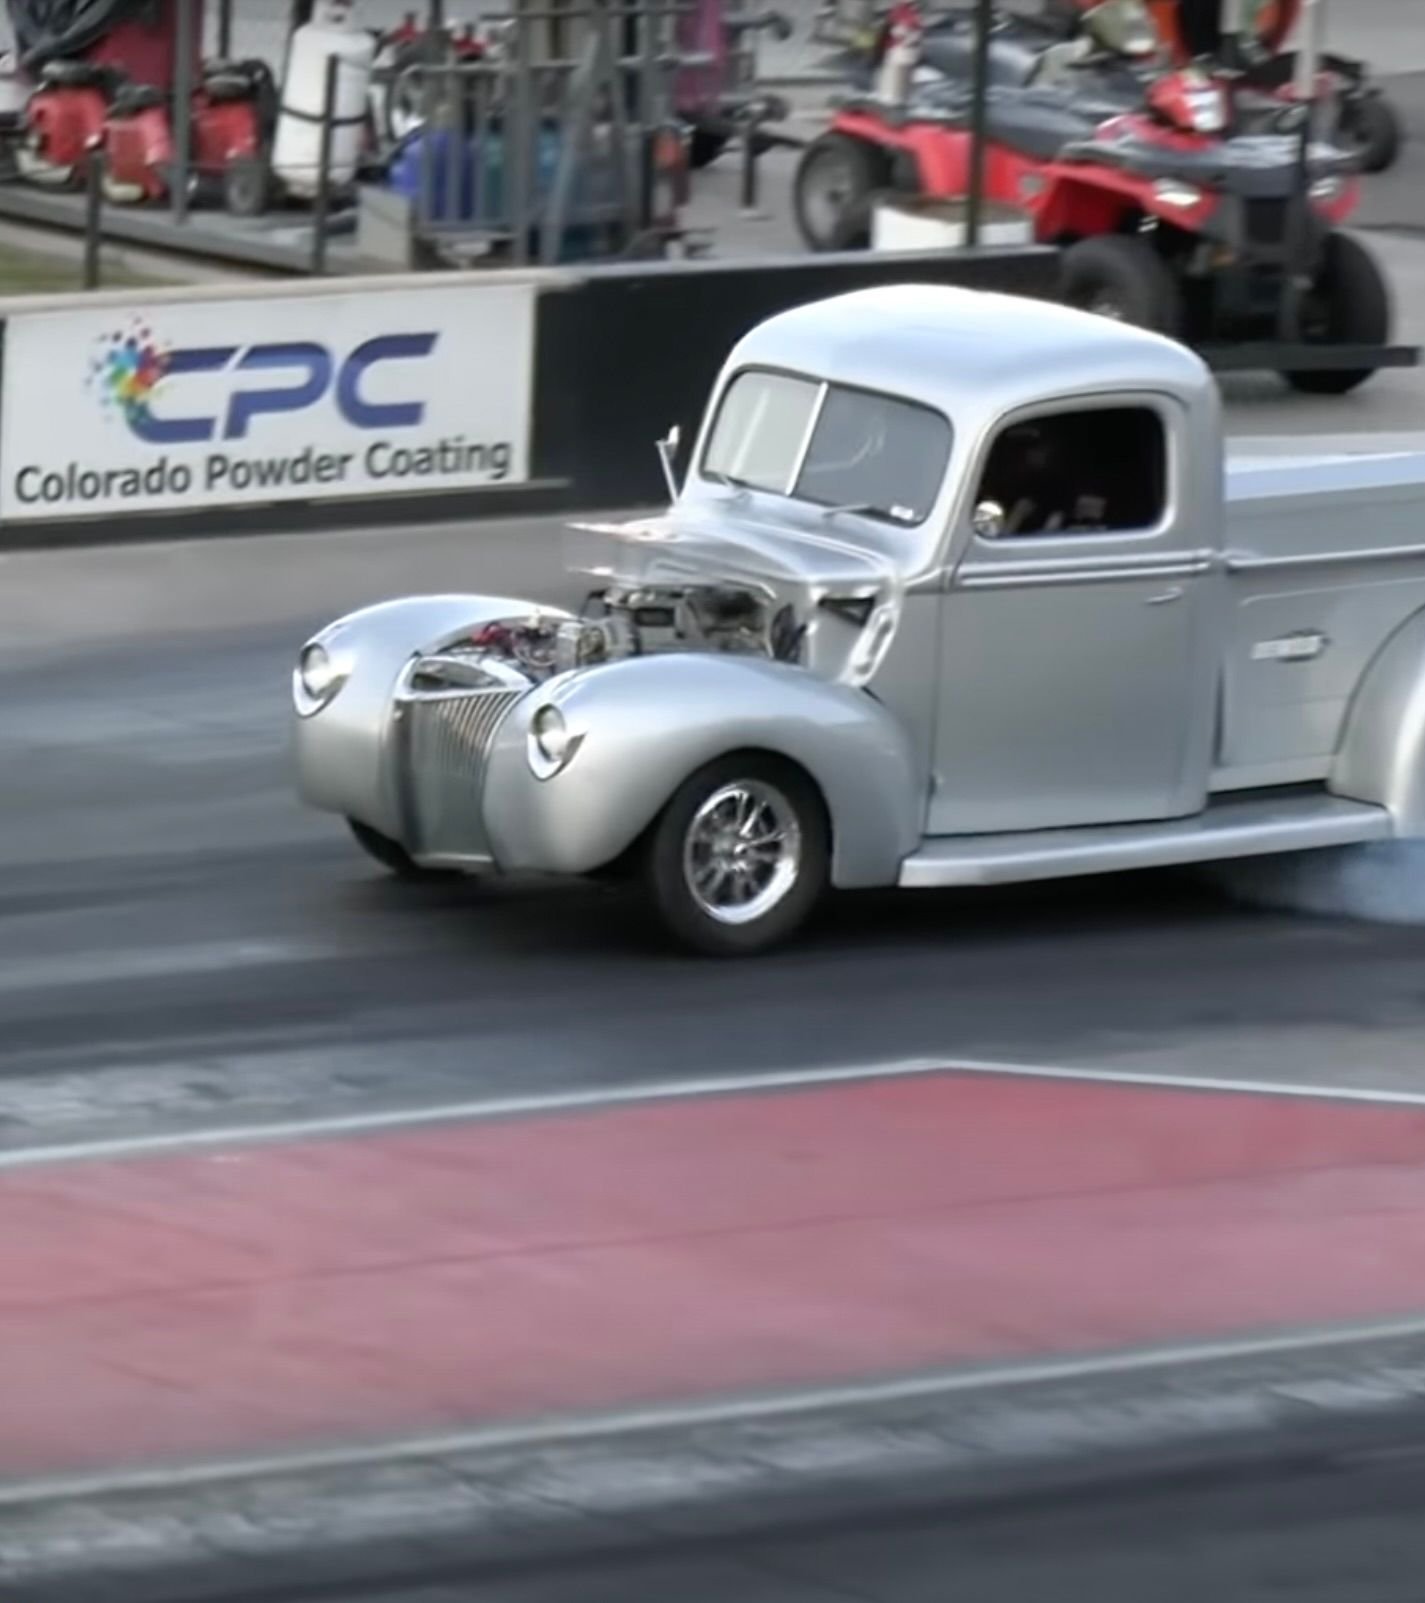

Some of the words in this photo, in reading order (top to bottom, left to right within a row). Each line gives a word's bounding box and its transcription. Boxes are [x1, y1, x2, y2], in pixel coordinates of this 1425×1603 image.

[122, 332, 439, 443] CPC
[14, 457, 192, 502] Colorado
[205, 446, 353, 491] Powder
[365, 436, 512, 479] Coating
